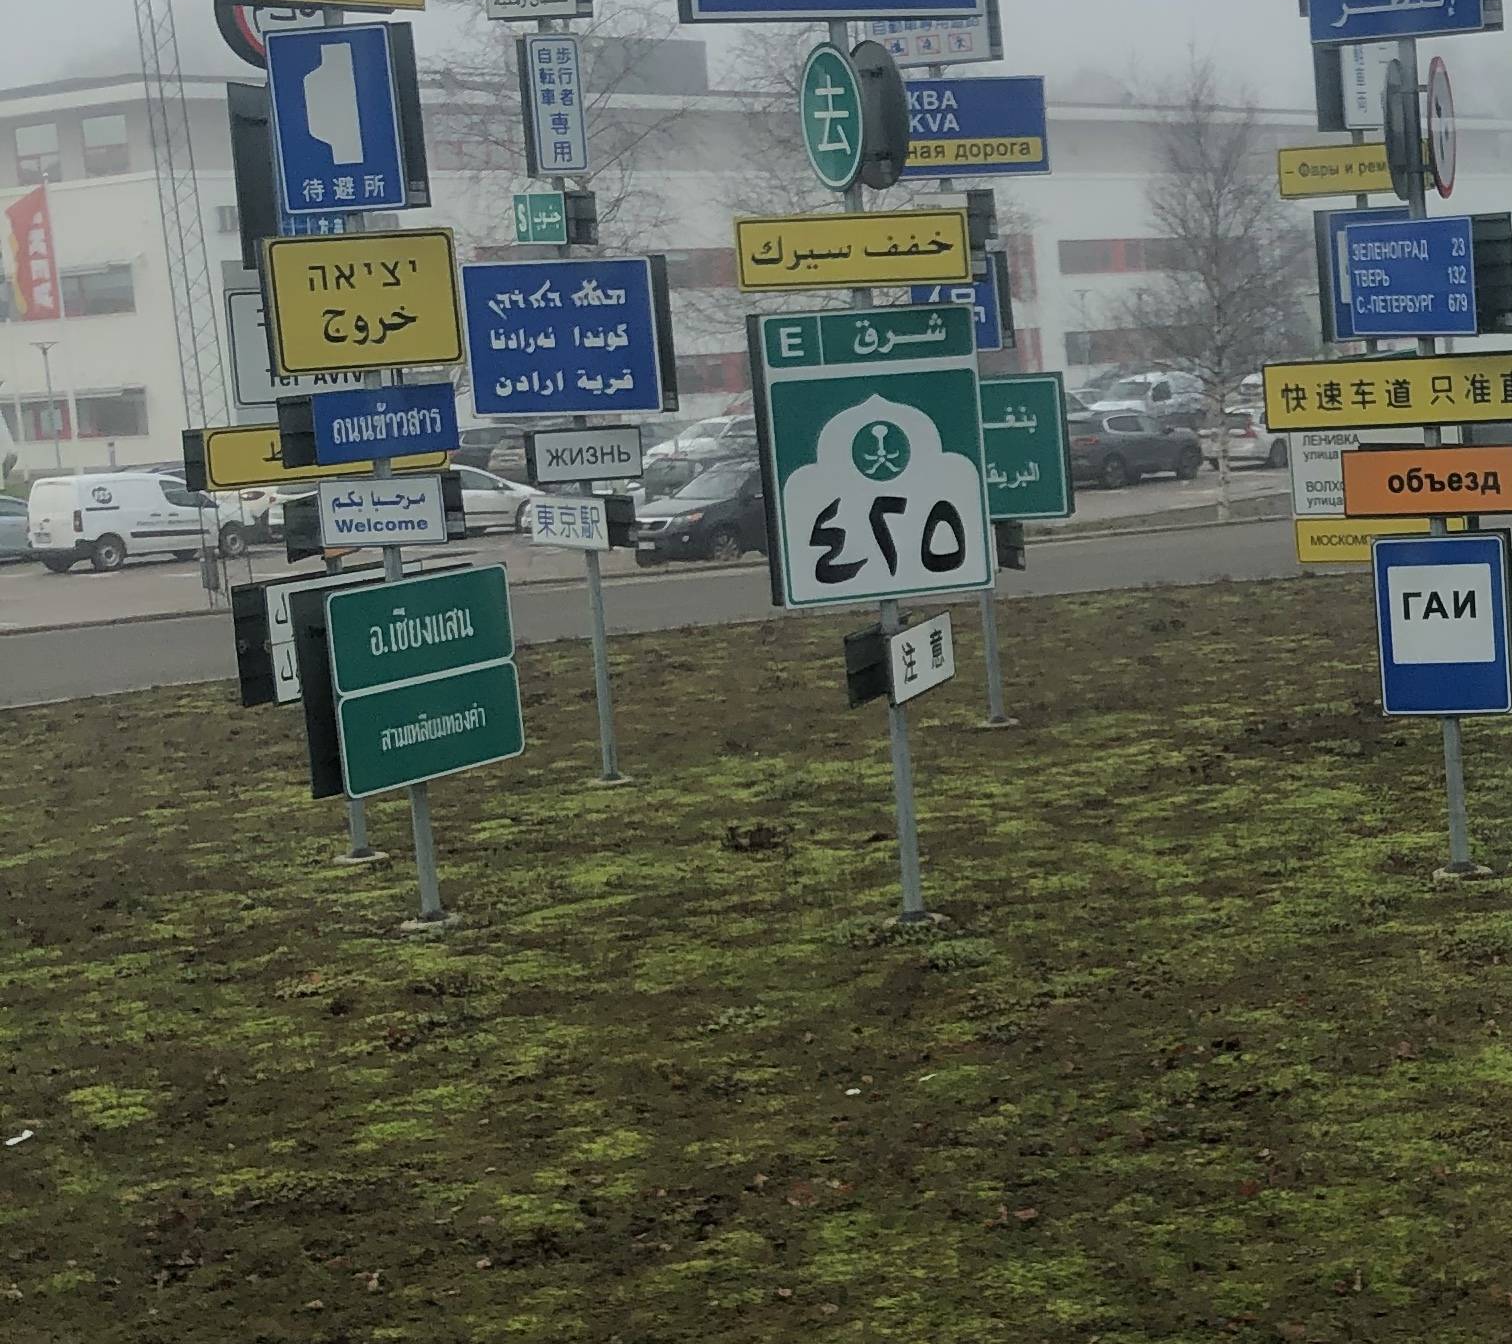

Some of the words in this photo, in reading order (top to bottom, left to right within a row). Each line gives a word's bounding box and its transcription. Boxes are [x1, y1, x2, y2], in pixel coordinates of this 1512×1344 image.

[907, 90, 958, 111] КВА
[909, 113, 960, 133] KVA
[955, 141, 1031, 161] дорога
[1298, 161, 1339, 179] Фары
[303, 174, 385, 202] 待避所
[516, 203, 528, 233] S
[750, 237, 854, 270] سيرك
[863, 230, 955, 258] خفف
[1352, 240, 1429, 261] ЗЕЛЕНОГРАД
[1451, 237, 1466, 257] 23
[308, 259, 418, 291] יציאה
[1353, 269, 1390, 288] ТВЕРЬ
[1447, 265, 1467, 285] 132
[1356, 294, 1435, 314] С.-ПЕТЕРБУРГ
[1447, 292, 1468, 313] 679
[322, 305, 418, 346] خروج
[853, 312, 947, 355] شرق
[779, 326, 805, 358] E
[576, 369, 634, 395] قرية
[1281, 379, 1413, 413] 快速车道
[332, 403, 442, 444] ถนนข้าวสาร
[1303, 451, 1339, 462] улица
[985, 461, 1041, 489] البريق
[1388, 467, 1501, 495] объезд
[331, 491, 364, 514] بكم
[370, 490, 426, 512] مرحبا
[334, 516, 429, 533] Welcome
[535, 504, 603, 540] 東京駅
[809, 495, 966, 584] ٤٢٥
[1402, 590, 1477, 620] ГАИ
